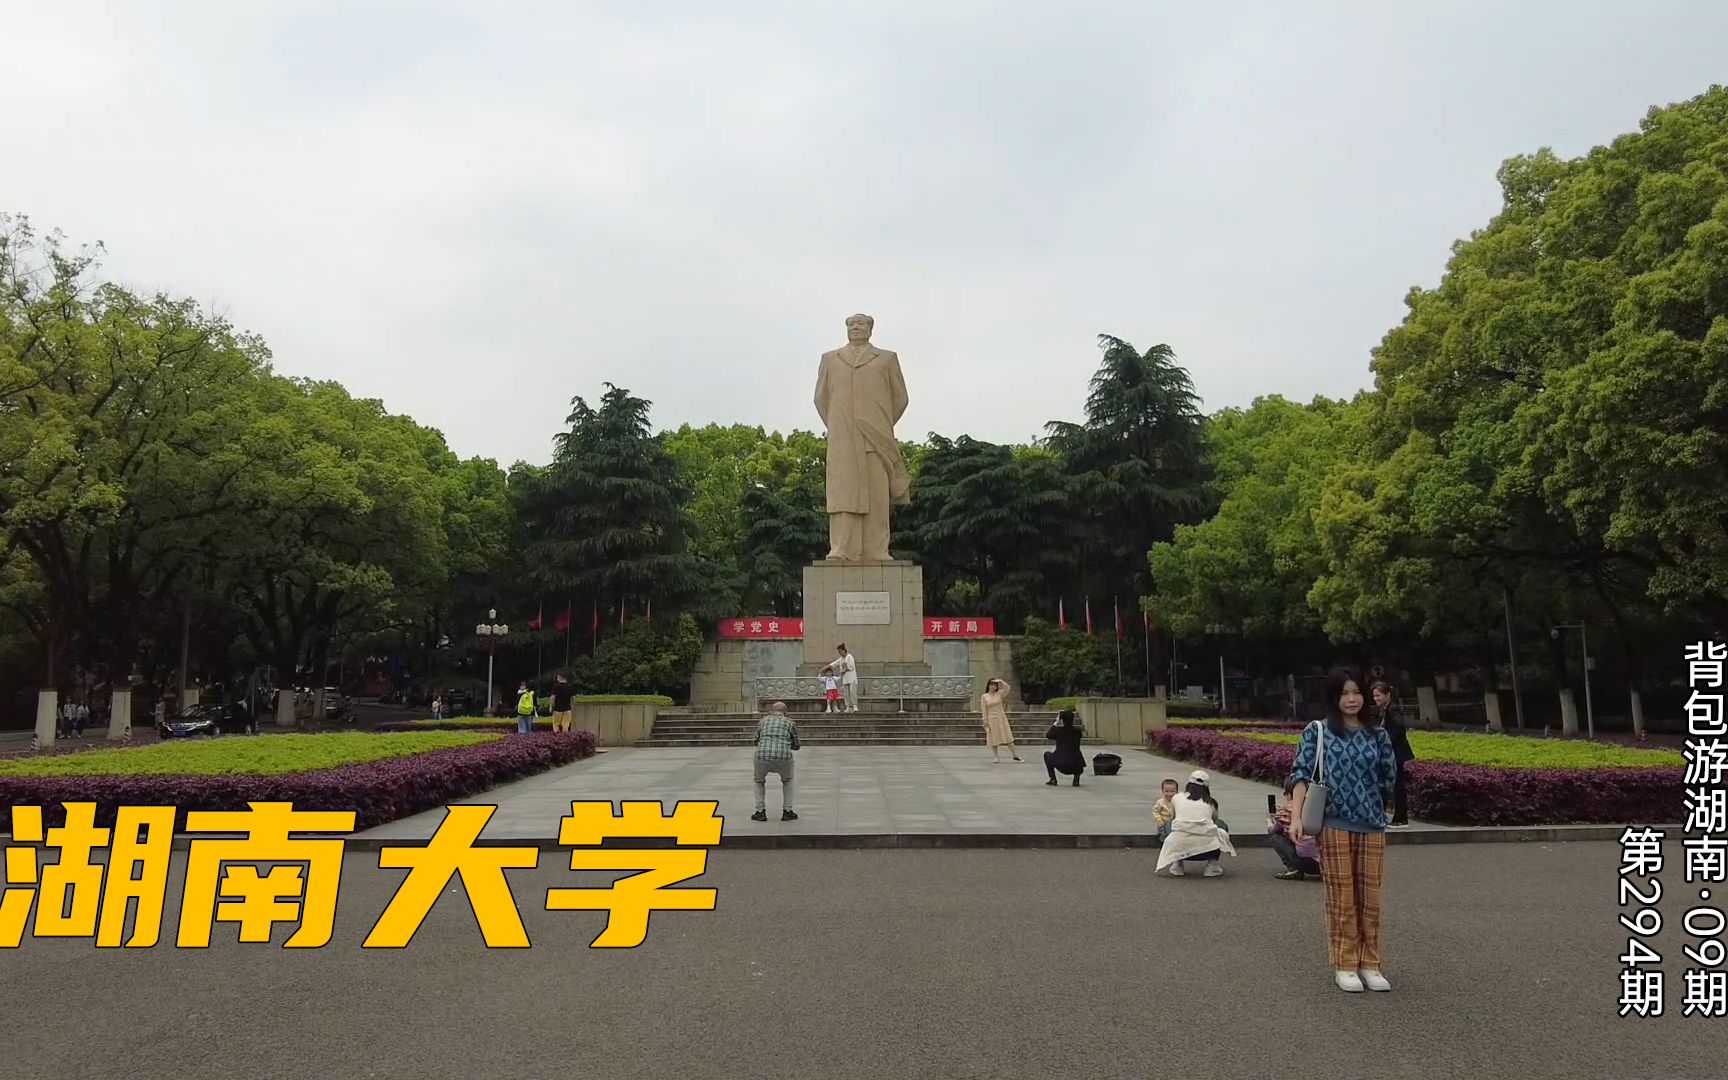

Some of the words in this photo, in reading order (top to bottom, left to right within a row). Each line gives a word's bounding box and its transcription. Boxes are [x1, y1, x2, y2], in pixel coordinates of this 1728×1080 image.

[733, 621, 779, 633] 学党史
[931, 621, 978, 633] 开新局
